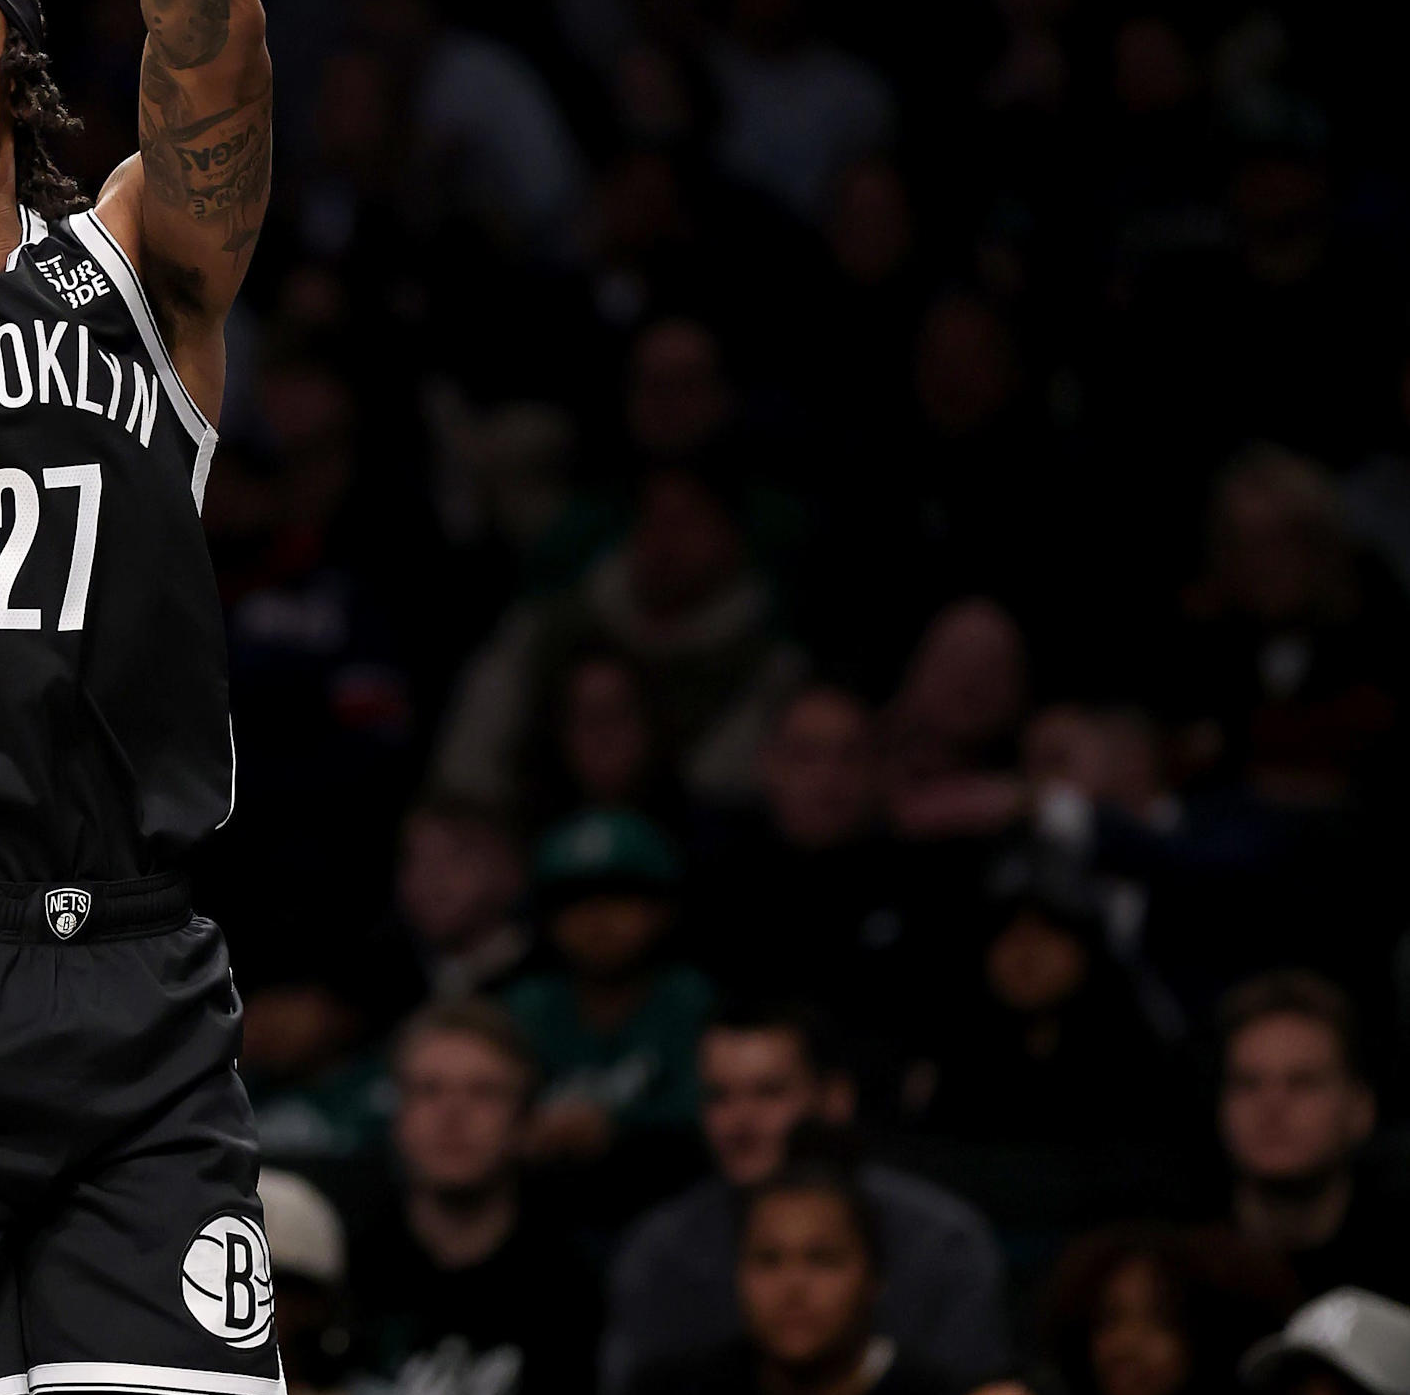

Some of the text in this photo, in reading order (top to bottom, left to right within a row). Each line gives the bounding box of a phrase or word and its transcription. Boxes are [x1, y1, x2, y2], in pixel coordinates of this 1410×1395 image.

[35, 254, 62, 279] ET
[50, 893, 87, 914] NETS
[225, 1232, 256, 1329] B
